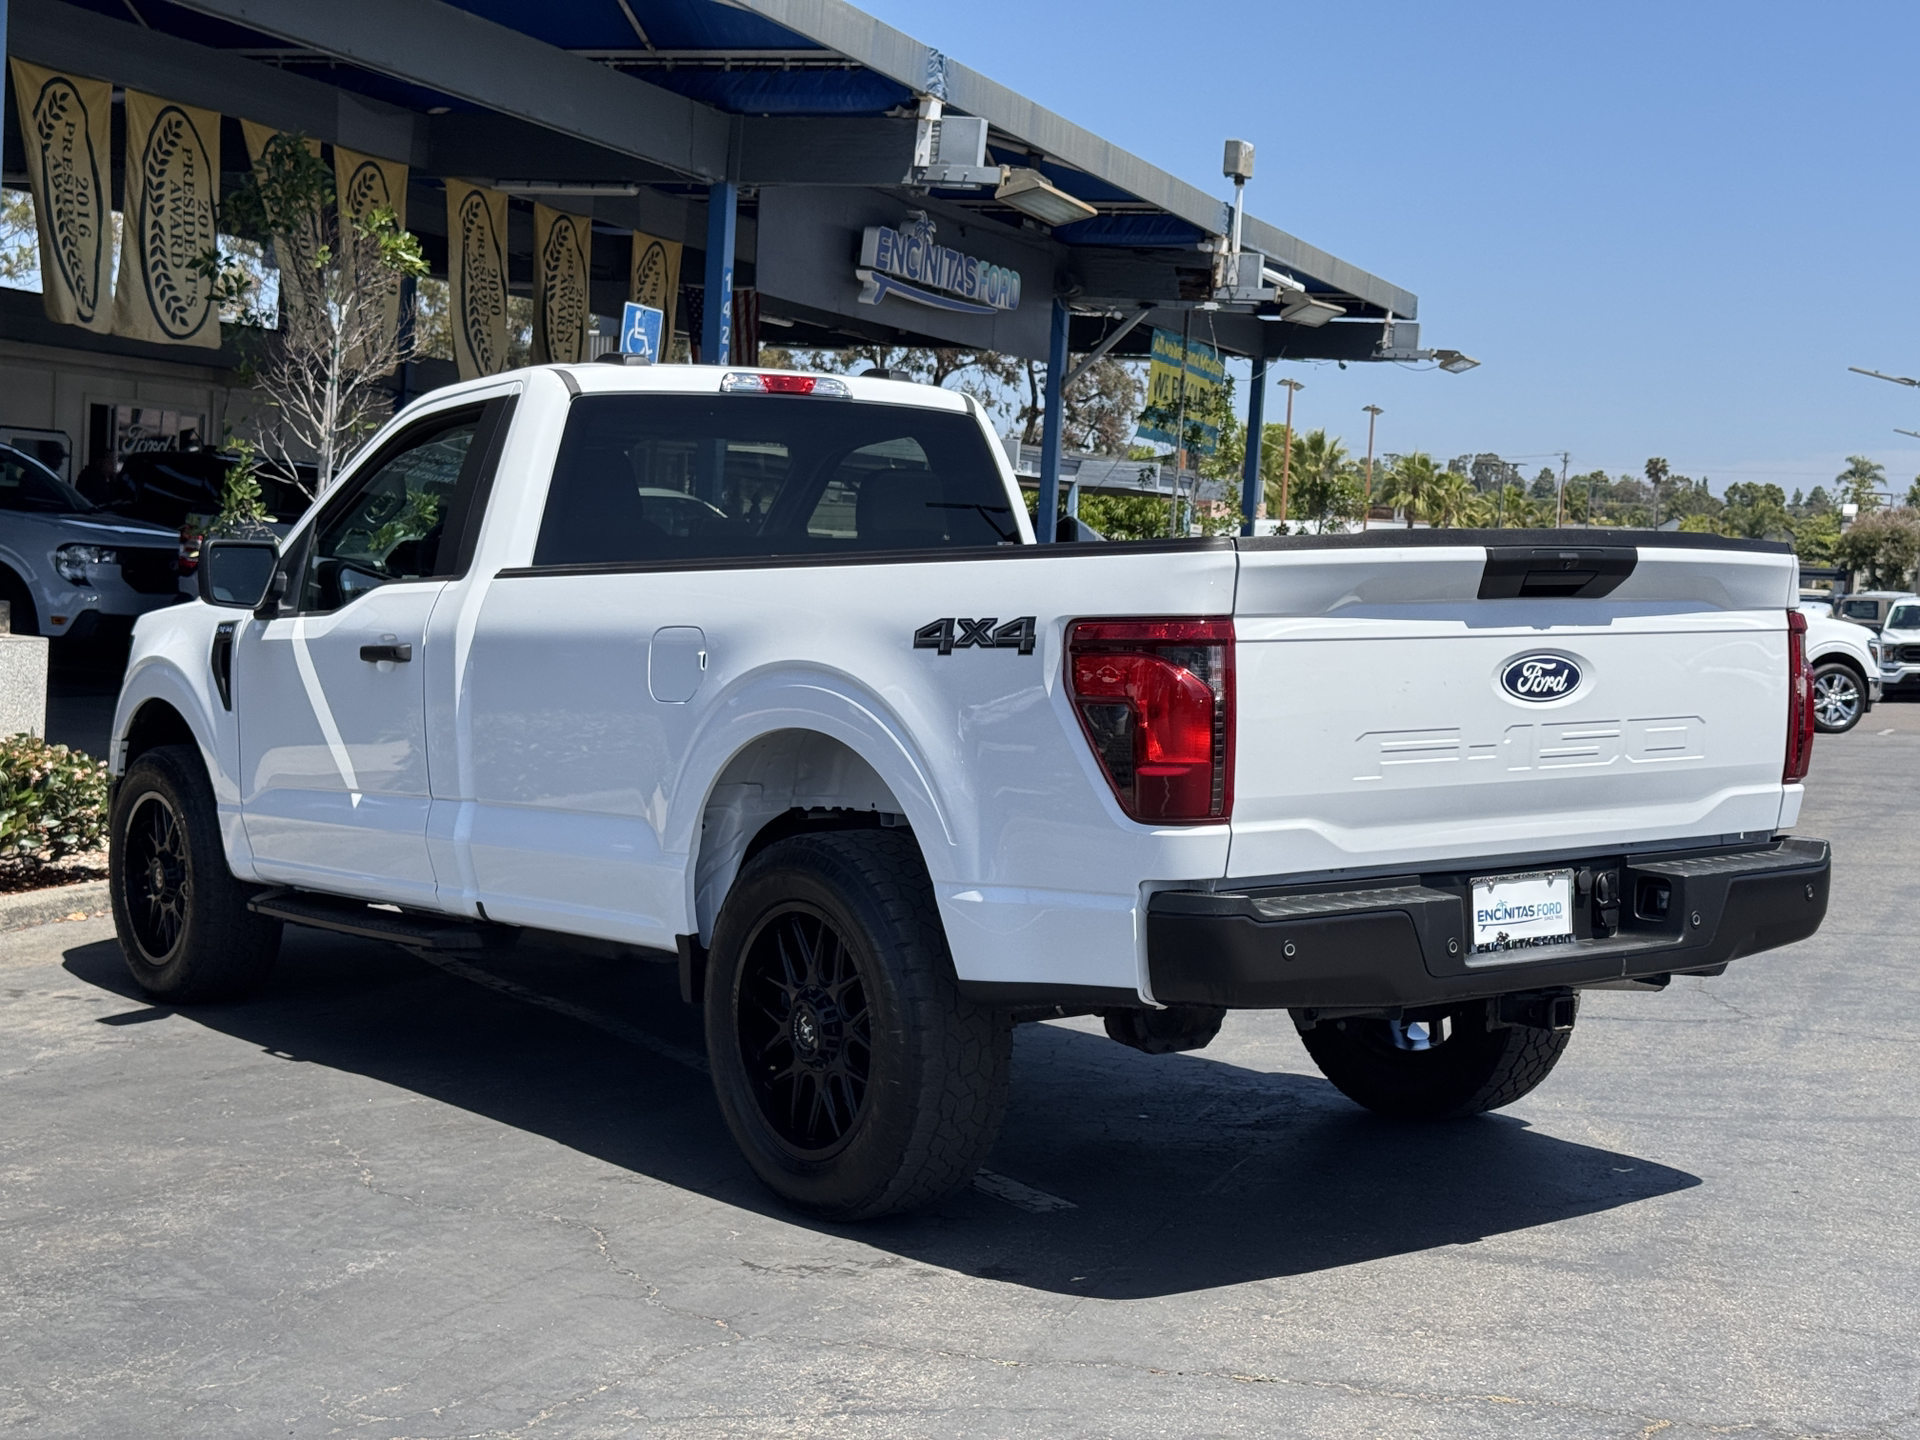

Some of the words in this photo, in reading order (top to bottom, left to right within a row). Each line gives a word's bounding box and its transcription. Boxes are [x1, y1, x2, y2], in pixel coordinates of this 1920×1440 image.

[75, 175, 92, 238] 2016
[169, 179, 185, 270] AWARD
[487, 267, 502, 316] 2020
[875, 225, 978, 297] ENCINITAS
[977, 260, 1022, 311] FORD
[556, 273, 568, 343] AWARD
[564, 247, 575, 362] PRESIDENT'
[1154, 372, 1170, 401] WE
[121, 423, 172, 453] Ford
[1516, 661, 1569, 694] Ford
[1353, 715, 1706, 781] F-150
[1477, 902, 1535, 922] ENCINITAS
[1536, 901, 1562, 917] FORD
